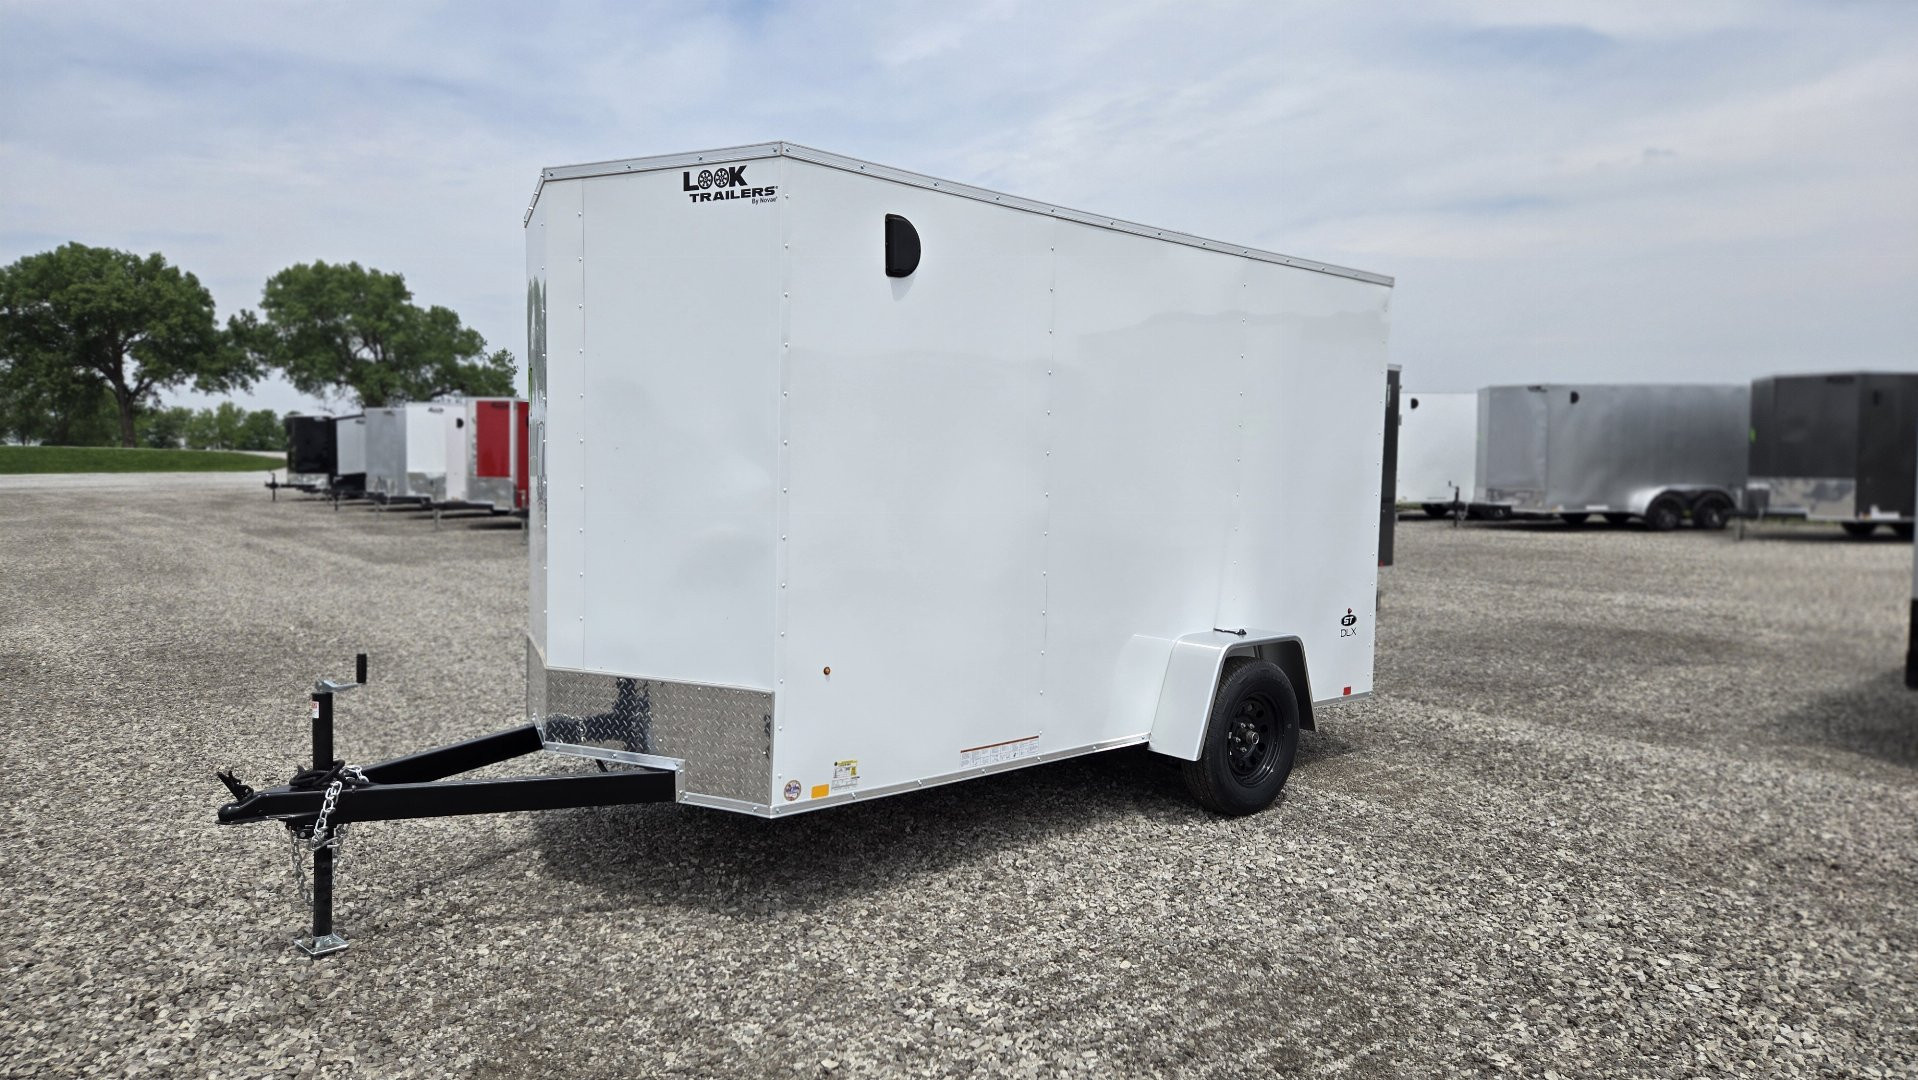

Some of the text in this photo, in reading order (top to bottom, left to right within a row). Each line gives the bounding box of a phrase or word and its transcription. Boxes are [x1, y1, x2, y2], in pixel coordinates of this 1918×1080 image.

[683, 165, 748, 191] LOOK
[689, 186, 776, 203] TRAILERS
[1340, 627, 1357, 638] DLX
